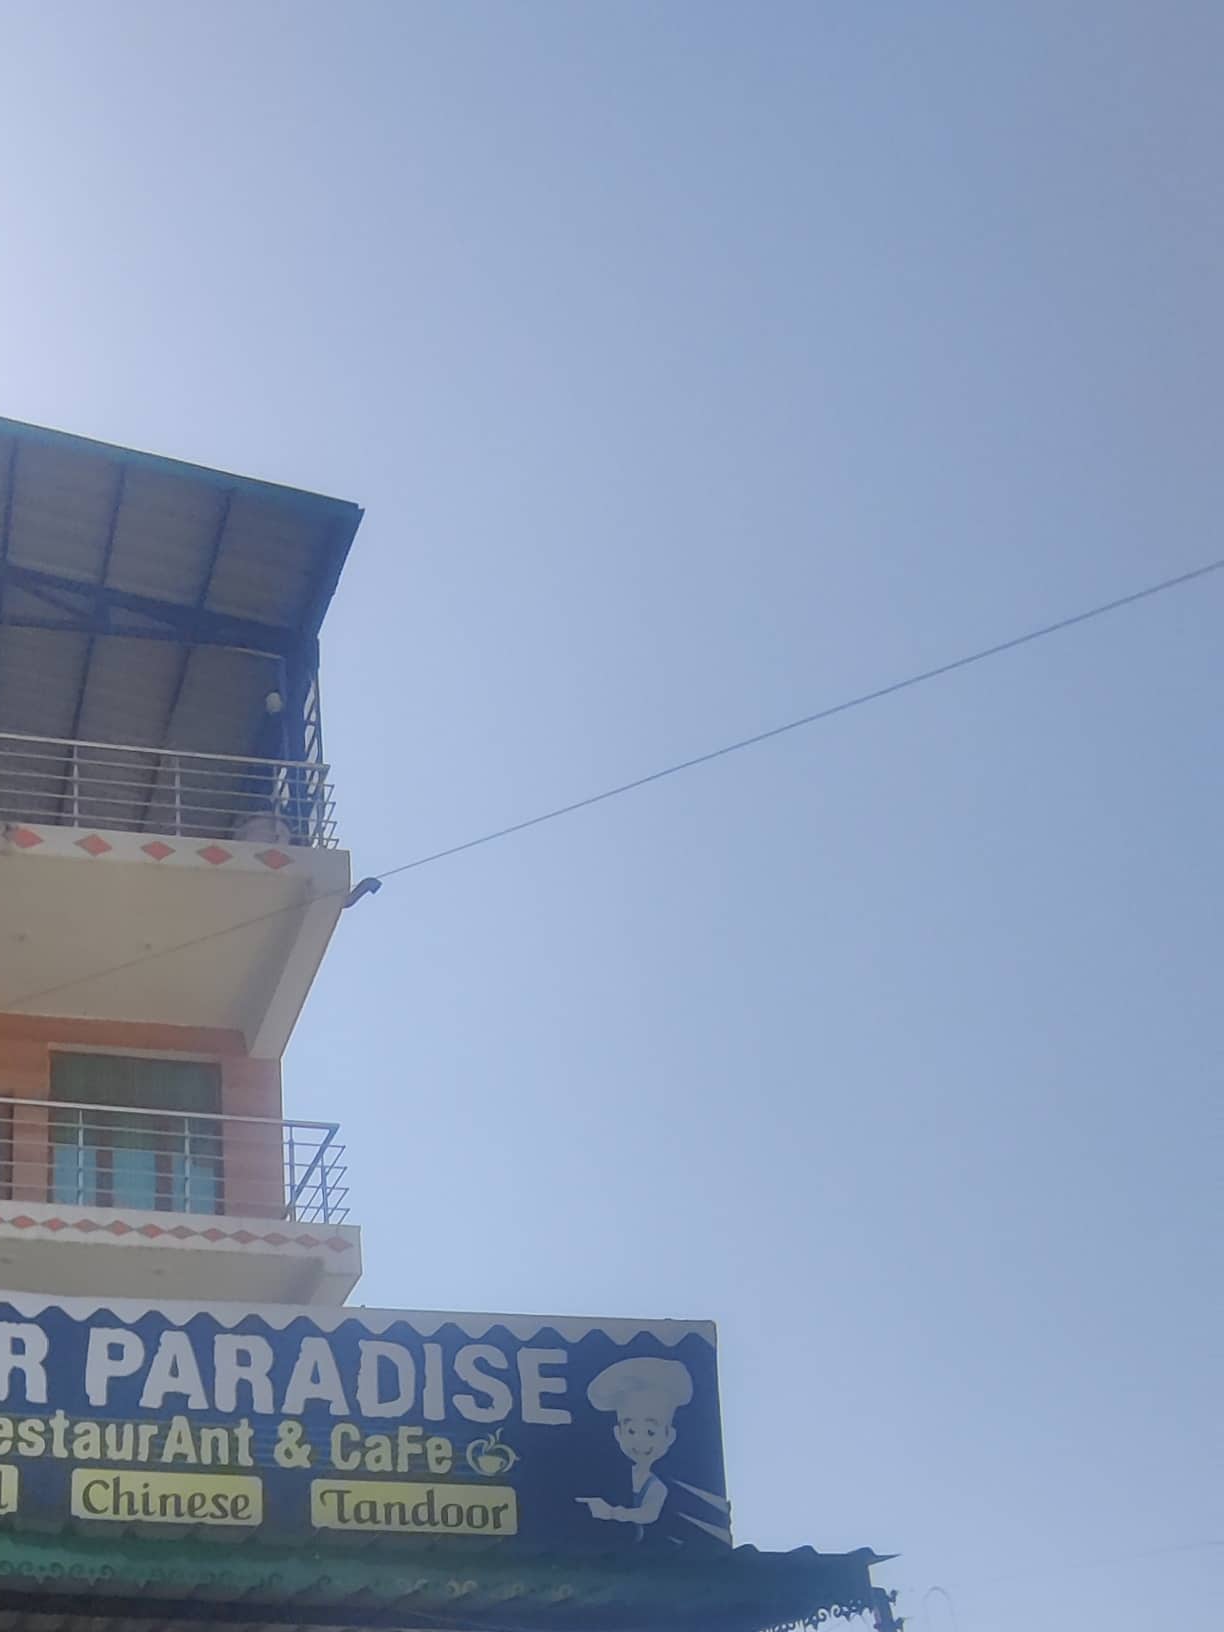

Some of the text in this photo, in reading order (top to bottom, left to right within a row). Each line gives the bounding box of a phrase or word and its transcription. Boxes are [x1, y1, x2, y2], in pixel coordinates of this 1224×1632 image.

[85, 1327, 573, 1425] PARADISE
[274, 1420, 311, 1469] &
[82, 1476, 253, 1521] Chinese
[319, 1488, 509, 1530] Tandoor
